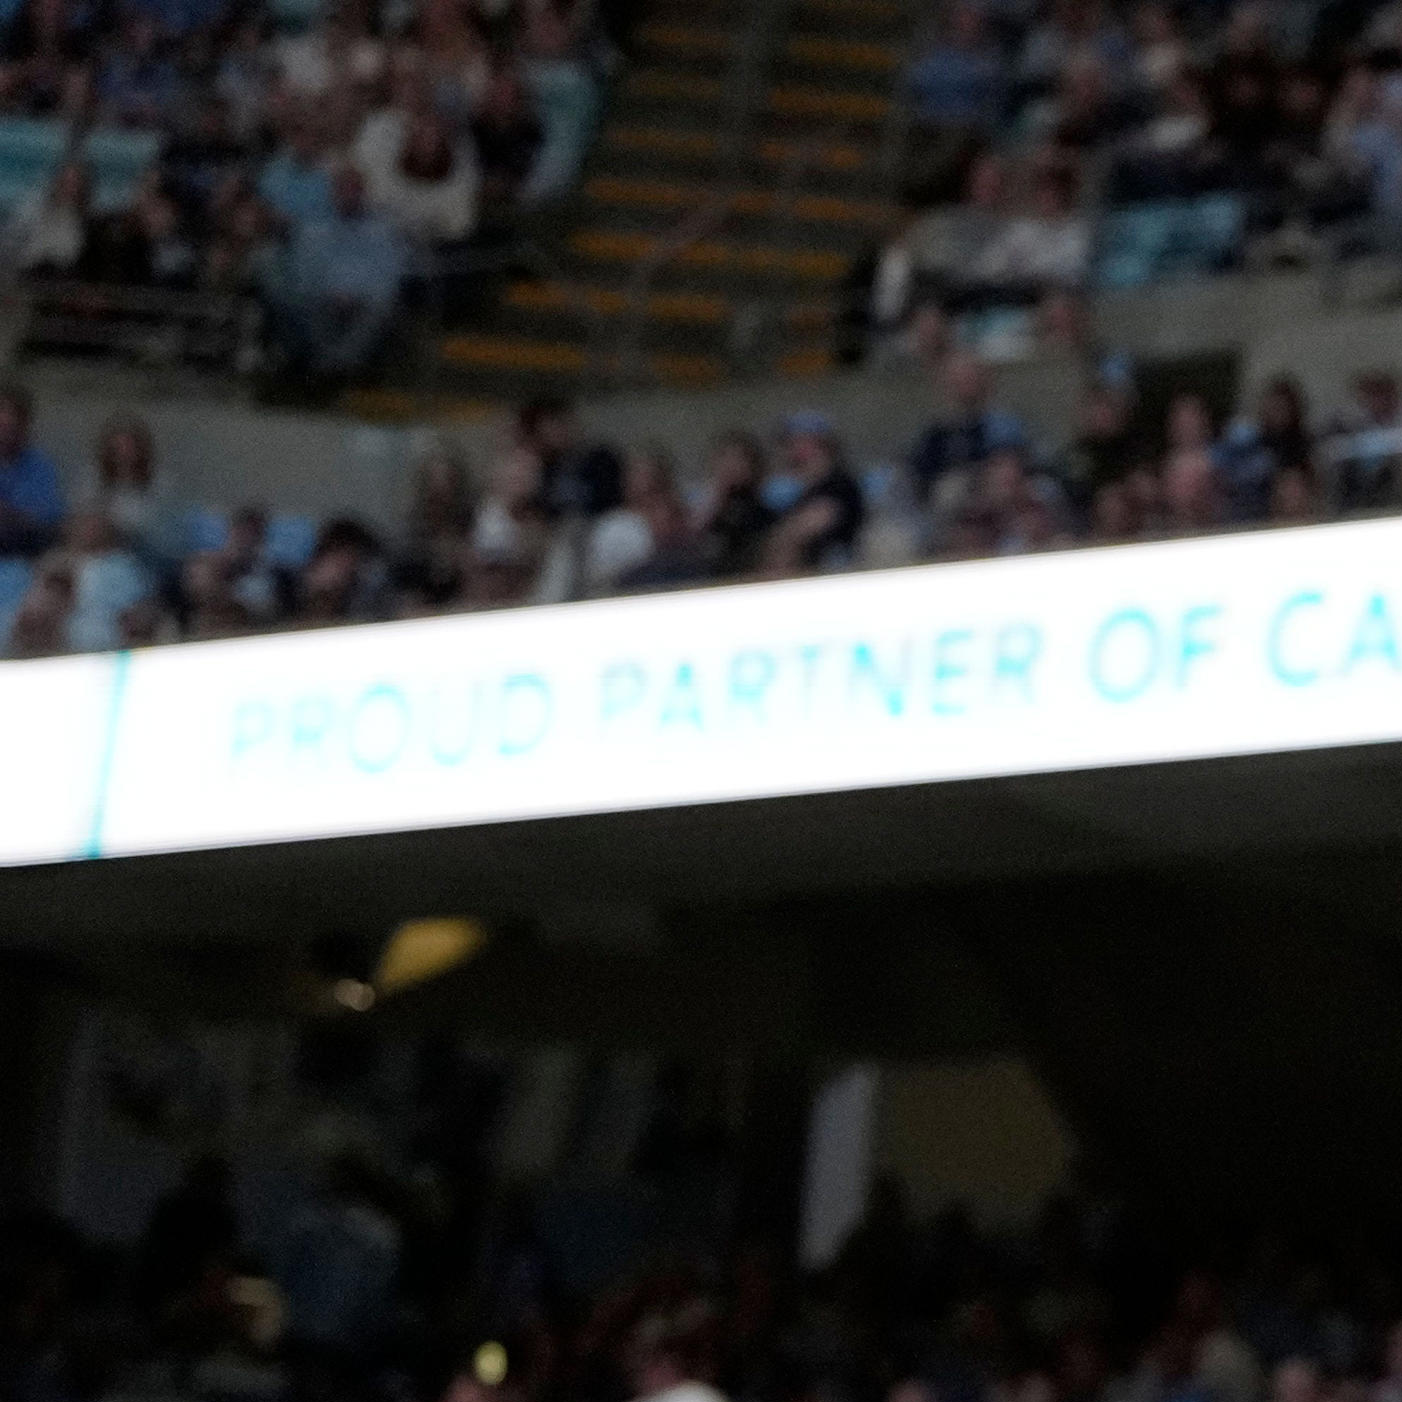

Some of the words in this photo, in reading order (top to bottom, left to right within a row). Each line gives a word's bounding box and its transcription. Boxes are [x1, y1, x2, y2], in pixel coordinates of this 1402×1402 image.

[228, 670, 556, 778] PROUD
[595, 620, 1047, 734] PARTNER
[1086, 604, 1221, 704] OF
